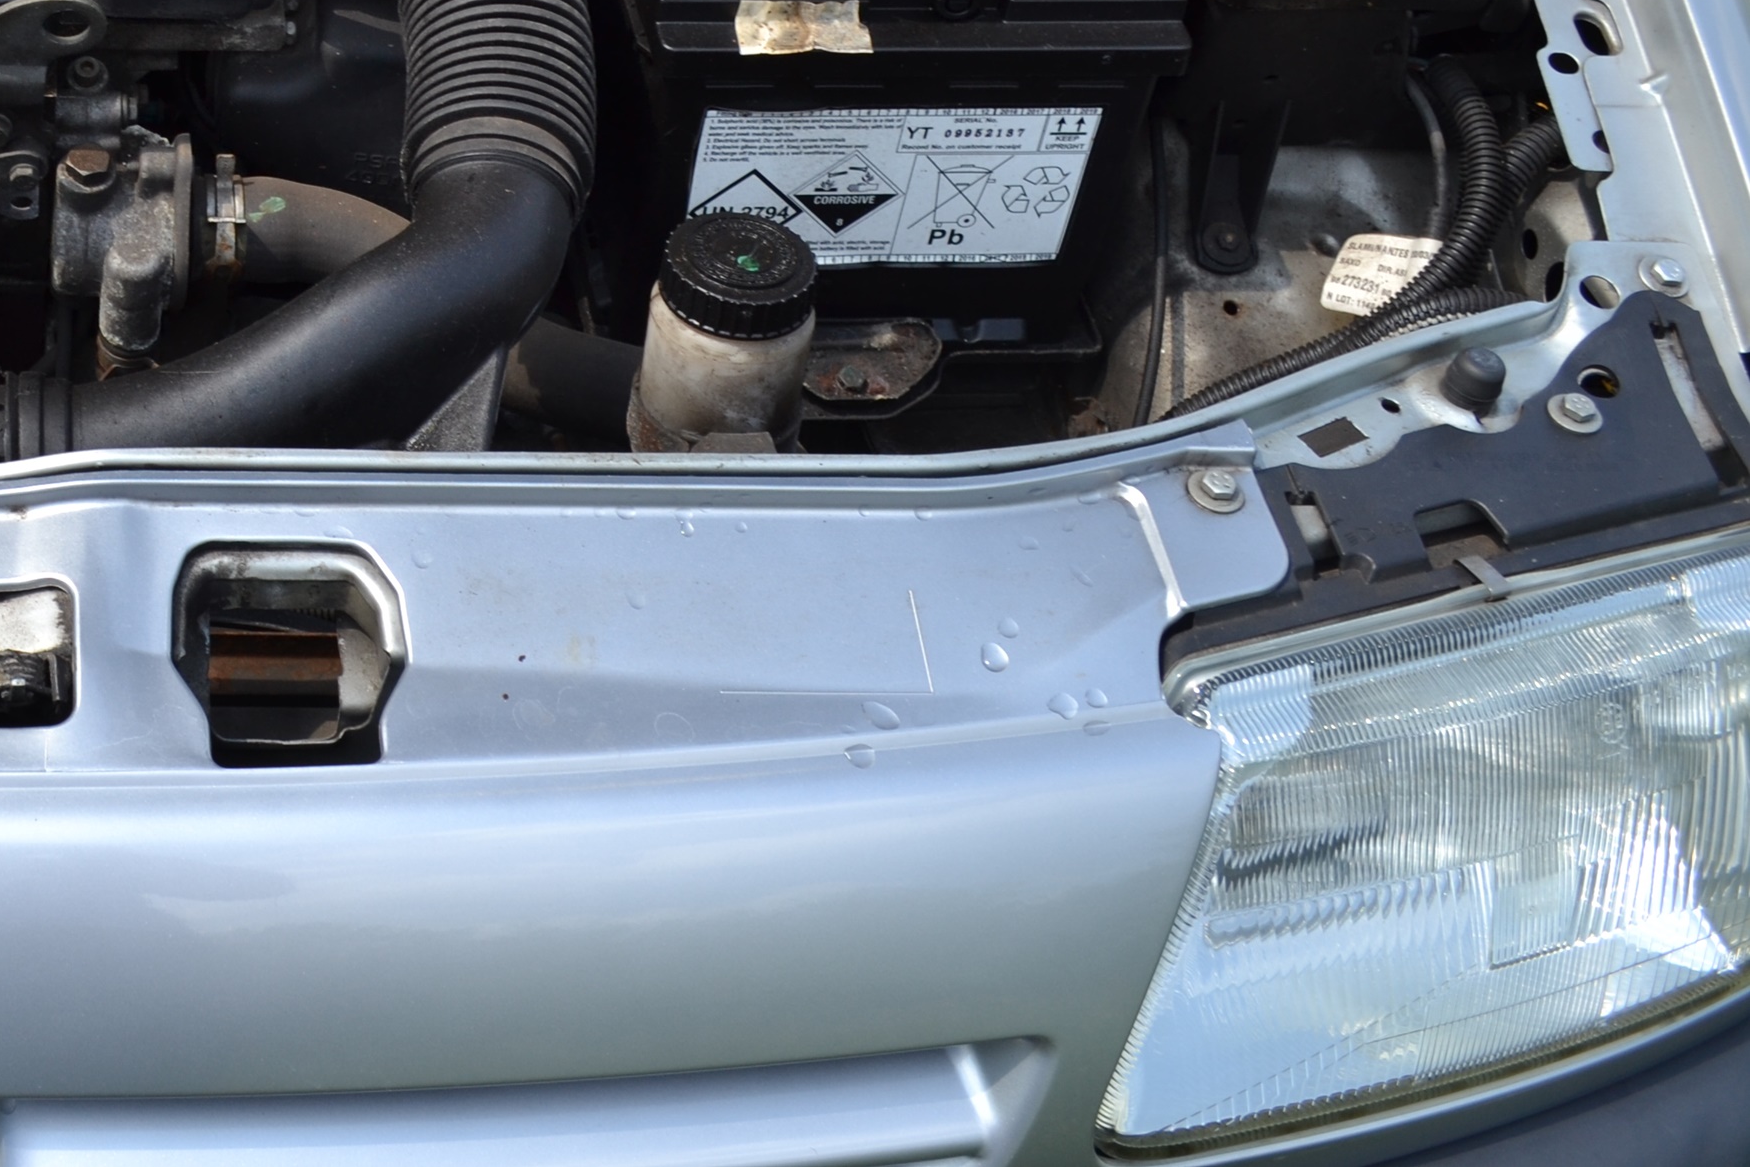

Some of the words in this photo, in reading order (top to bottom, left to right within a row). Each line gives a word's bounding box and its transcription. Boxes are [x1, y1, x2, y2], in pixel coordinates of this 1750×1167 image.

[907, 126, 933, 139] YT
[995, 143, 1022, 151] receipt
[813, 195, 876, 205] CORROSIVE
[702, 205, 733, 215] UN
[741, 205, 790, 219] 2794
[835, 218, 844, 227] 8
[927, 228, 965, 246] Pb
